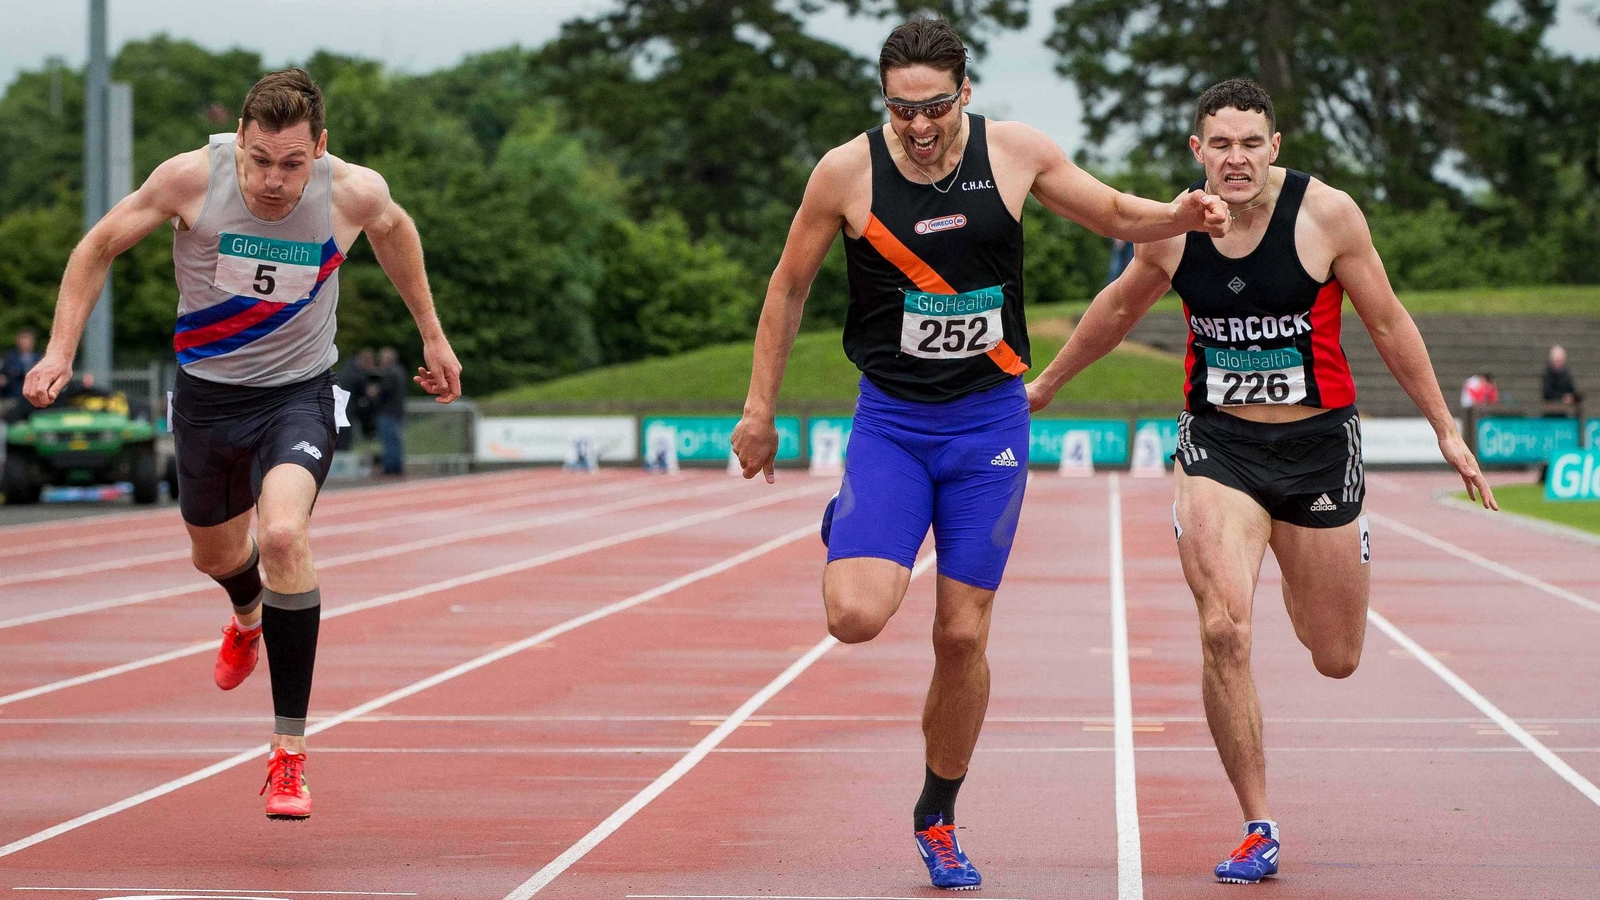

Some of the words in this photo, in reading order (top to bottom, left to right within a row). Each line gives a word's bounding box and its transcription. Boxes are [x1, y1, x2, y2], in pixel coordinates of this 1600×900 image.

[962, 180, 994, 191] C.H.A.C.
[931, 219, 954, 229] HIRECO
[232, 237, 310, 262] GloHealth
[252, 264, 277, 295] 5
[917, 291, 994, 313] GloHealth
[917, 316, 988, 353] 252
[1190, 310, 1312, 342] SHERCOCK
[1215, 351, 1291, 368] GloHealth
[1222, 372, 1290, 405] 226
[1363, 530, 1370, 561] 3
